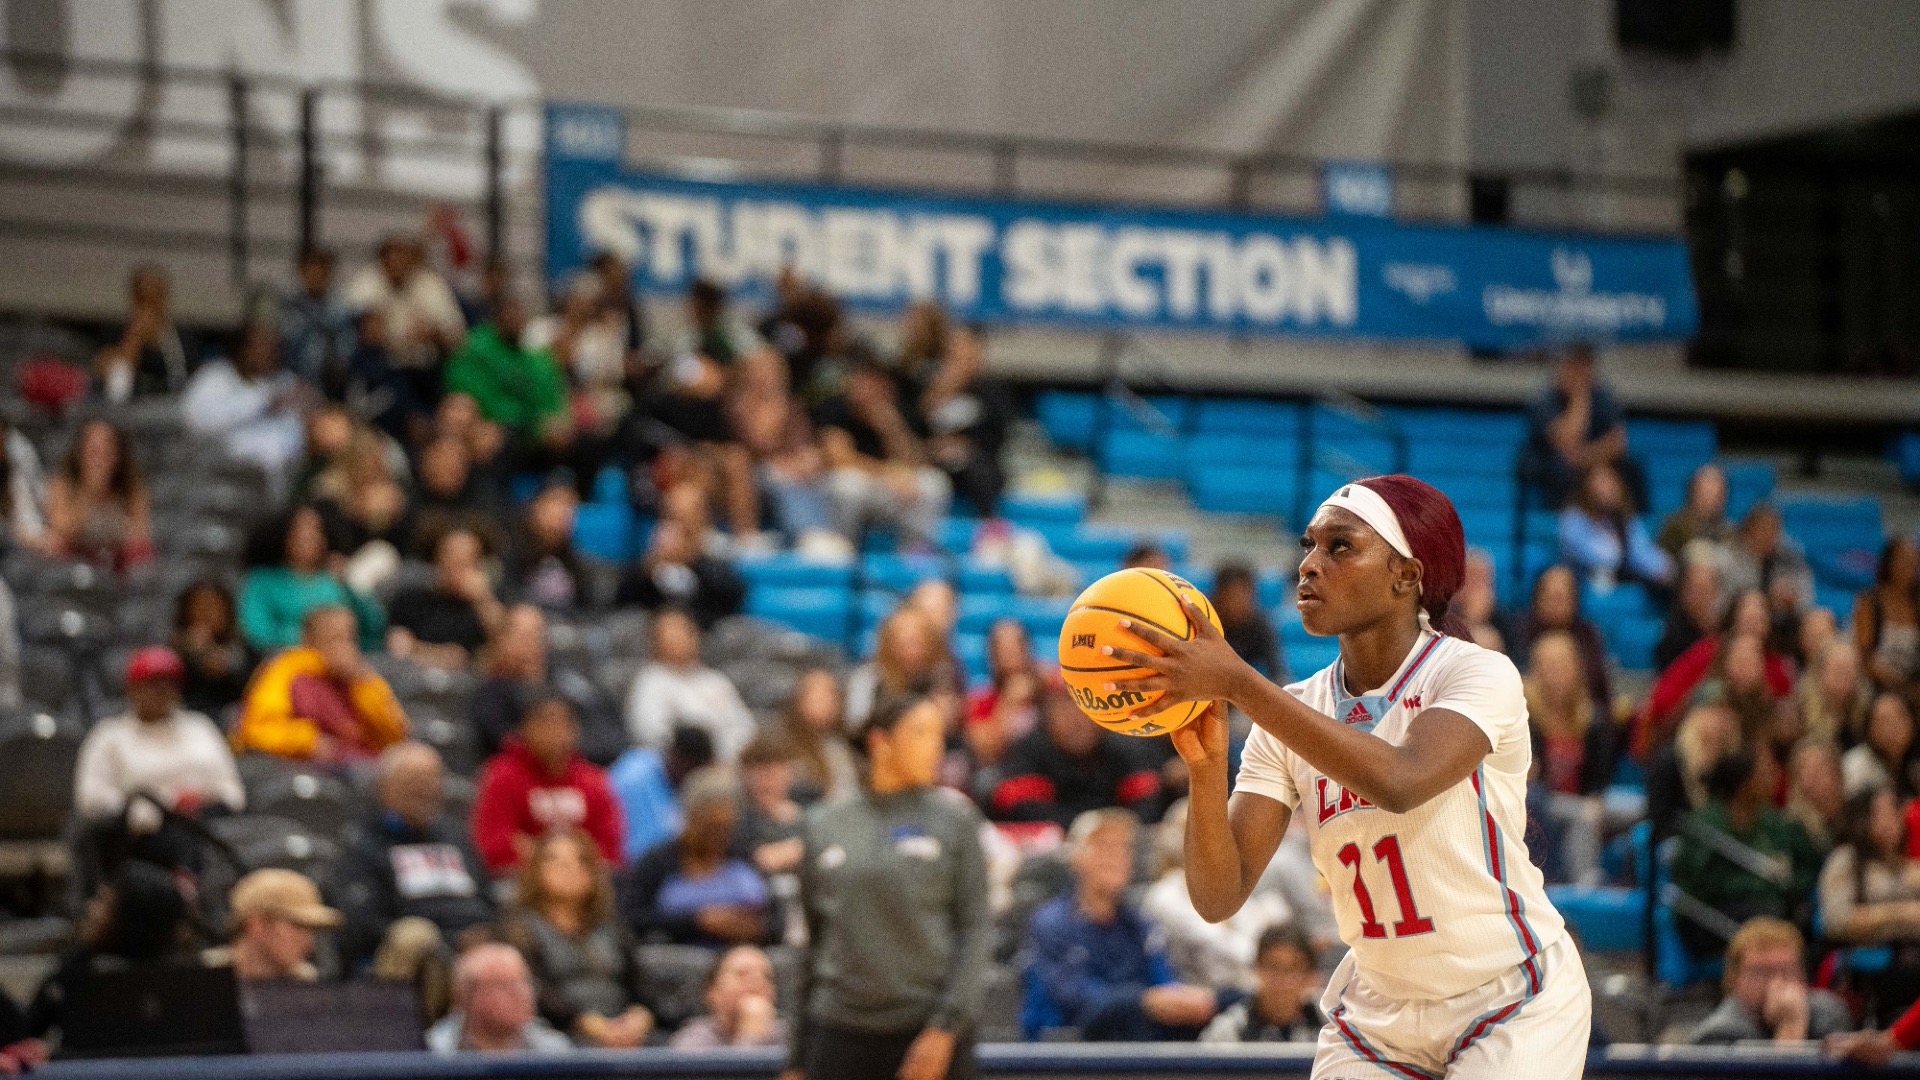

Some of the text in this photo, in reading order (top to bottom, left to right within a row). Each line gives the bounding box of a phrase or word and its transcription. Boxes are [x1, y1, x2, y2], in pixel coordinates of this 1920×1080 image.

[579, 186, 1359, 328] STUDENT SECTION
[1072, 634, 1096, 649] LMU
[1346, 713, 1374, 725] adidas
[1336, 833, 1437, 940] 11
